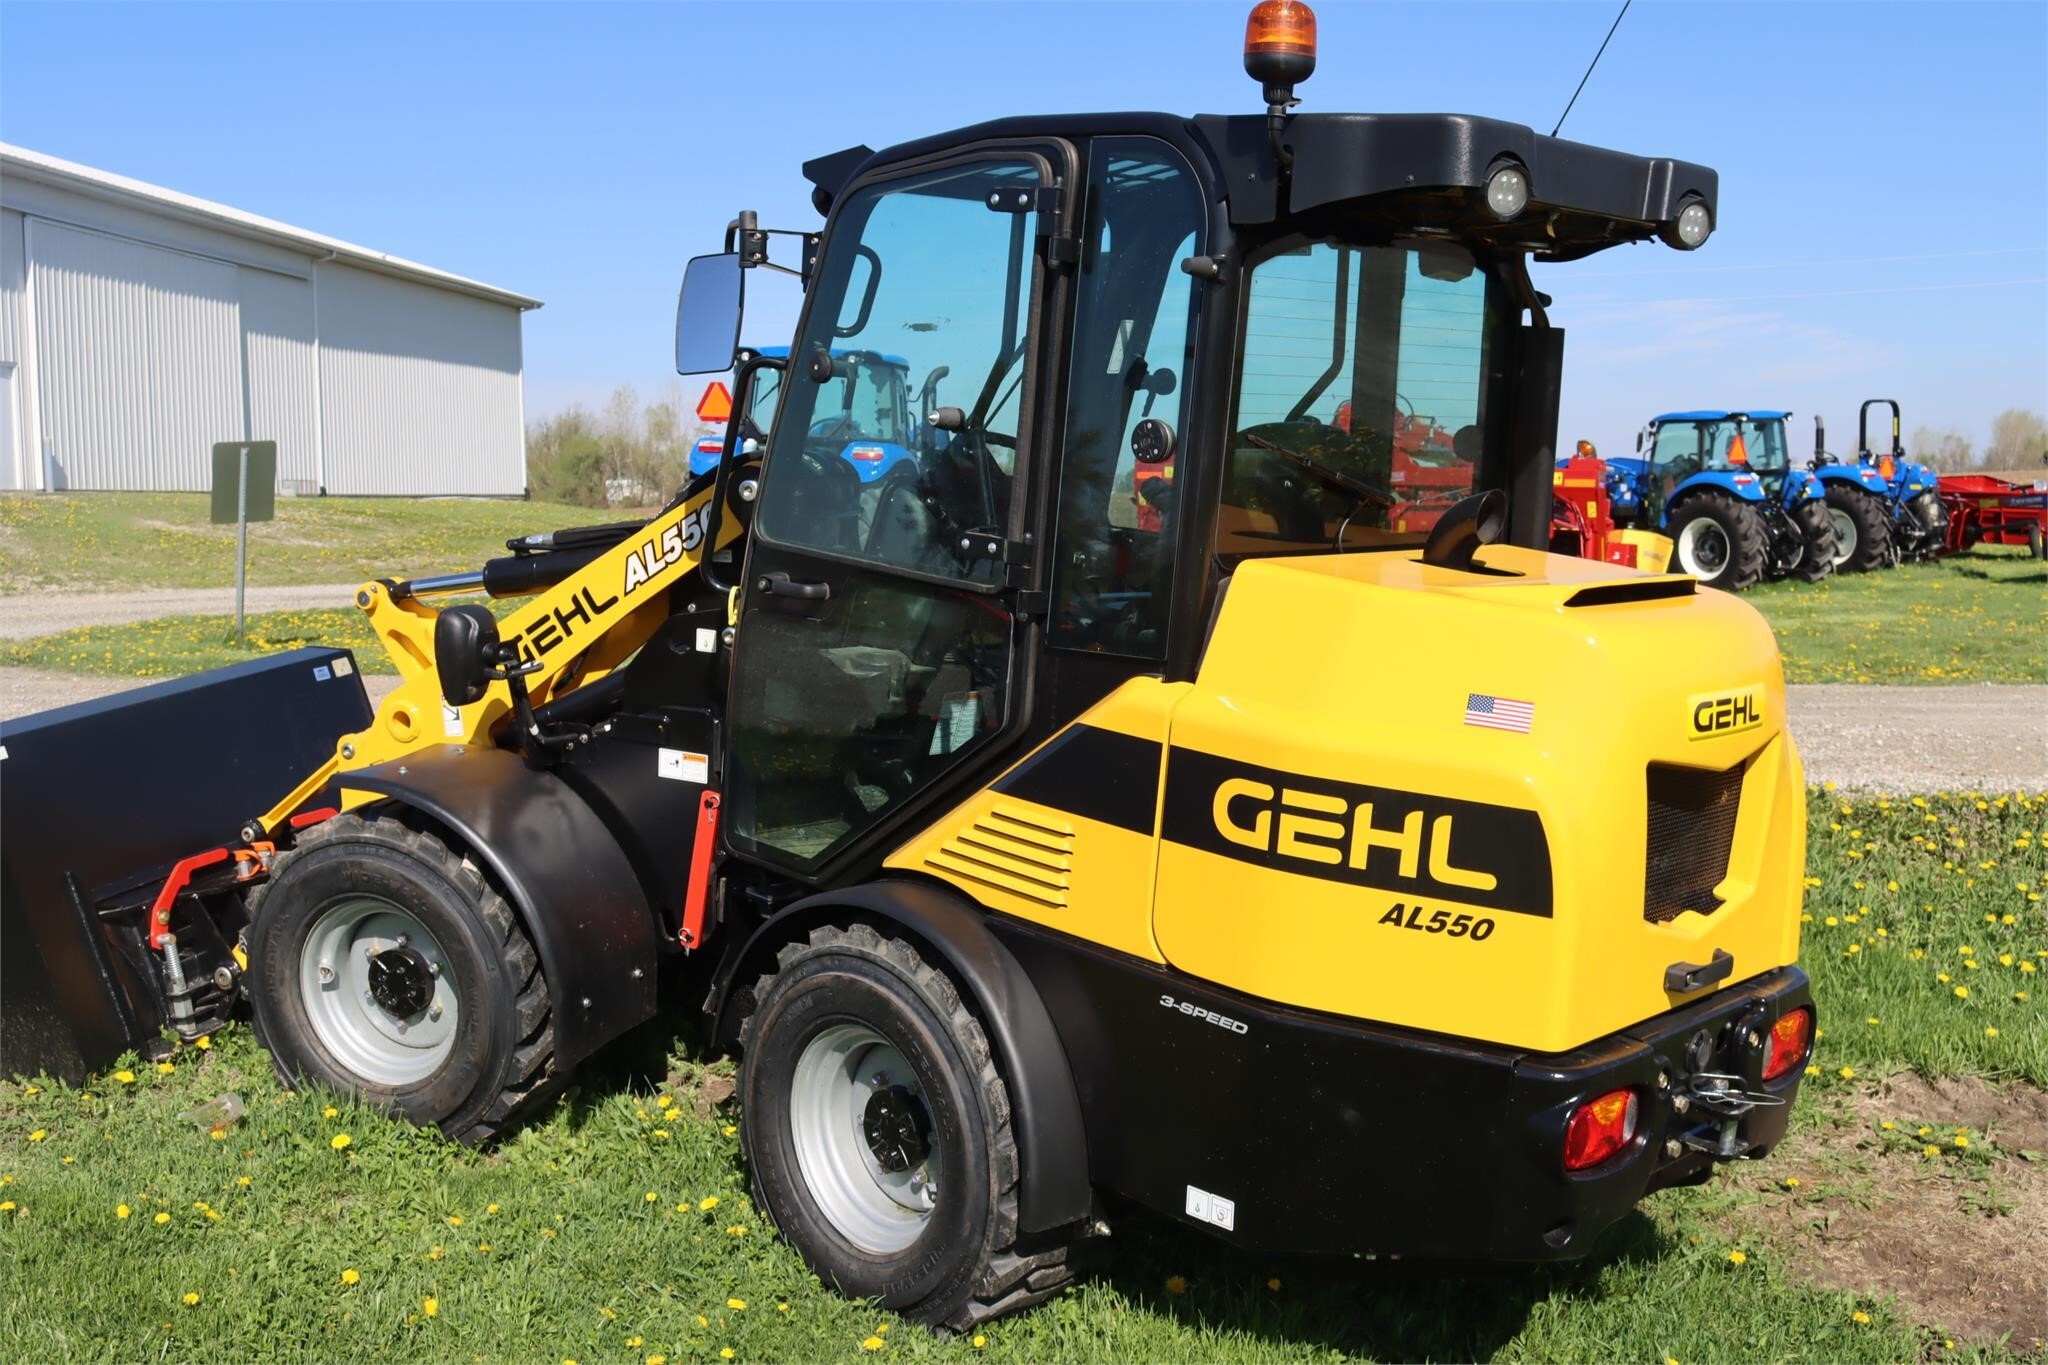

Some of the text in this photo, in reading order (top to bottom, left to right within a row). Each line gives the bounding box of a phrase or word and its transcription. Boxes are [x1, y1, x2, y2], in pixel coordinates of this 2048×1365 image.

[1693, 693, 1760, 733] GEHL
[1212, 777, 1497, 891] GEHL
[1377, 902, 1495, 941] AL550
[1159, 994, 1249, 1035] 3-SPEED
